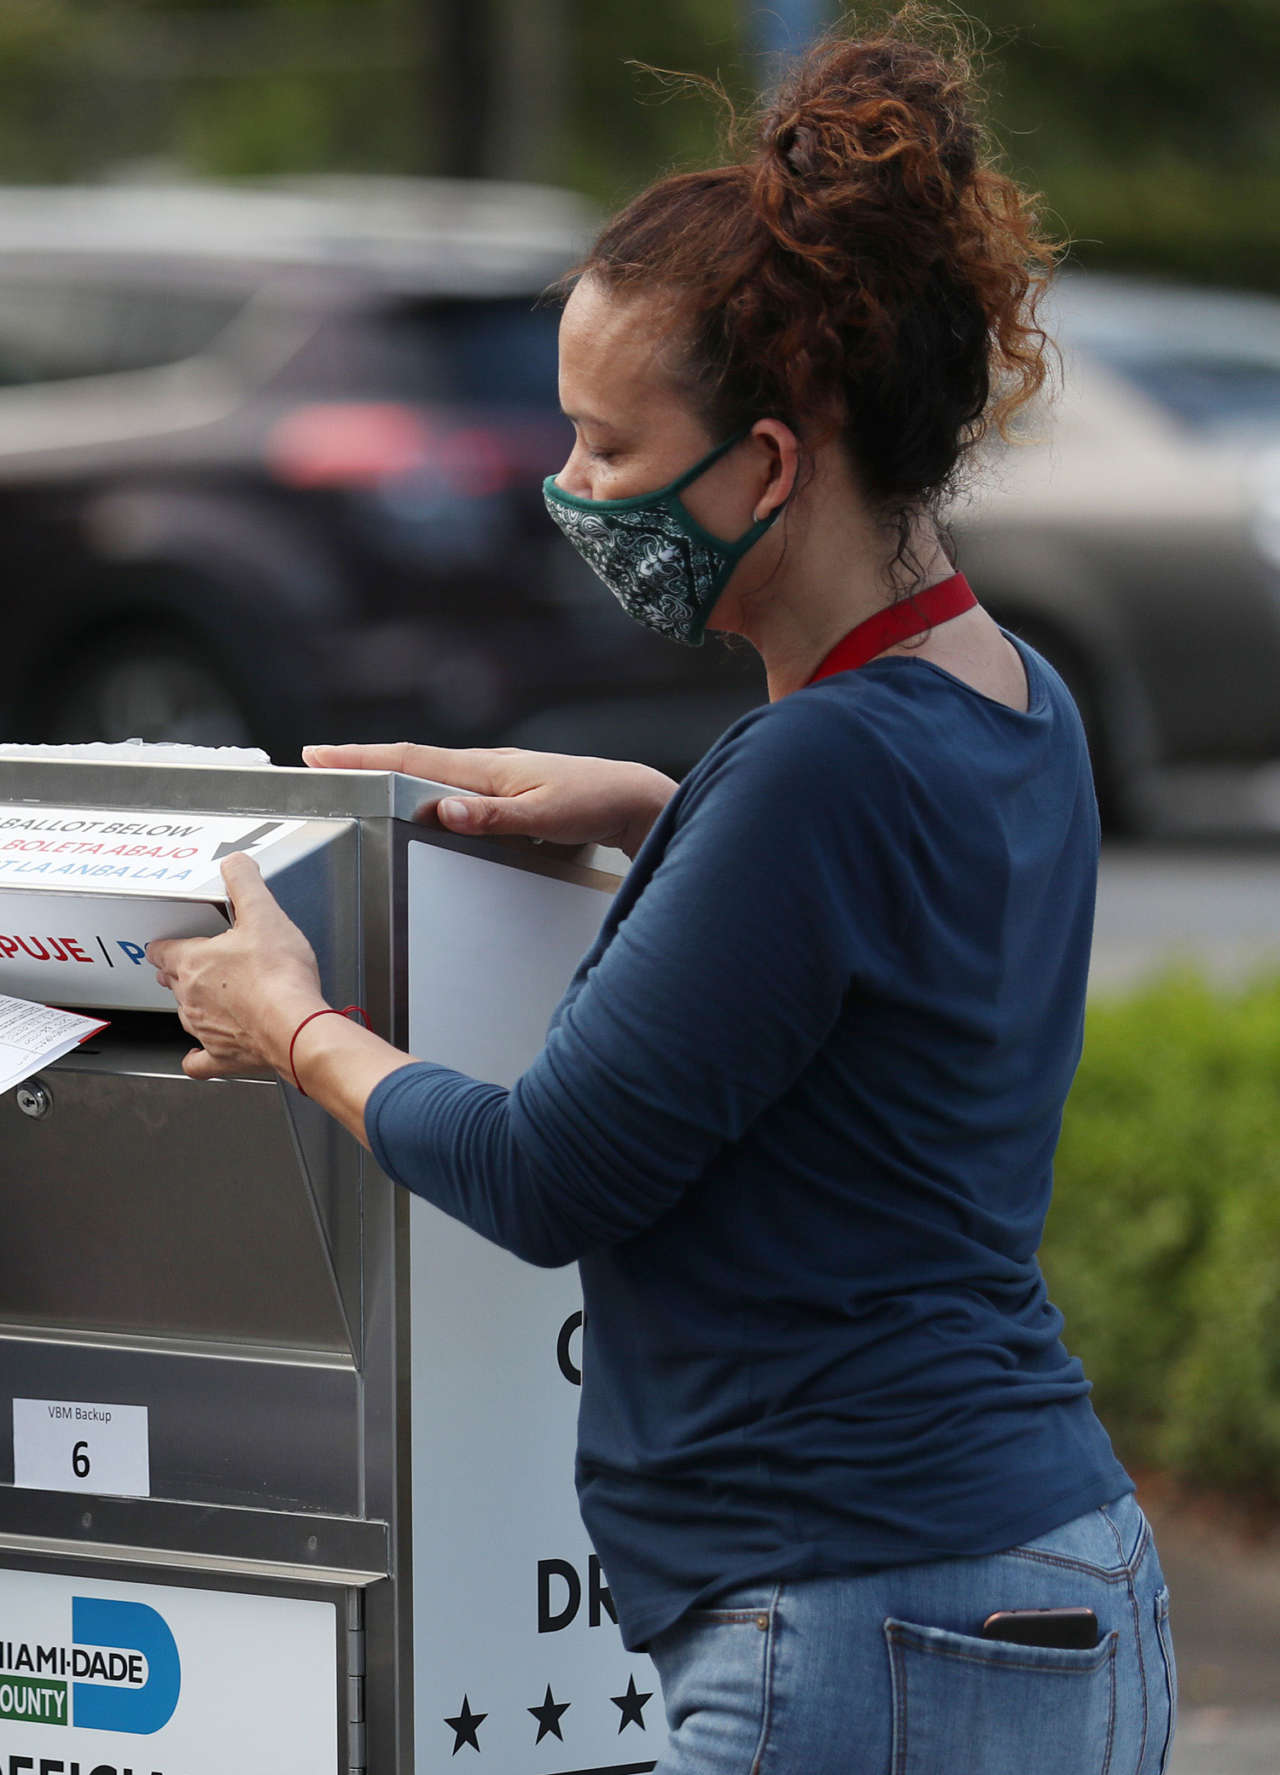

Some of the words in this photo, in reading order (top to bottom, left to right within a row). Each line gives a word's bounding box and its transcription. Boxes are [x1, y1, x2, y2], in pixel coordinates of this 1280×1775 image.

[100, 822, 203, 838] BELOW
[0, 839, 104, 855] BOLETA
[103, 844, 199, 860] ABAJO
[15, 862, 54, 874] LA
[50, 863, 129, 878] ANBA
[128, 868, 166, 881] LA
[166, 869, 194, 882] A
[116, 940, 151, 966] P
[47, 1406, 73, 1420] VBM
[75, 1407, 112, 1425] Backup
[72, 1440, 91, 1479] 6
[537, 1554, 620, 1634] DR
